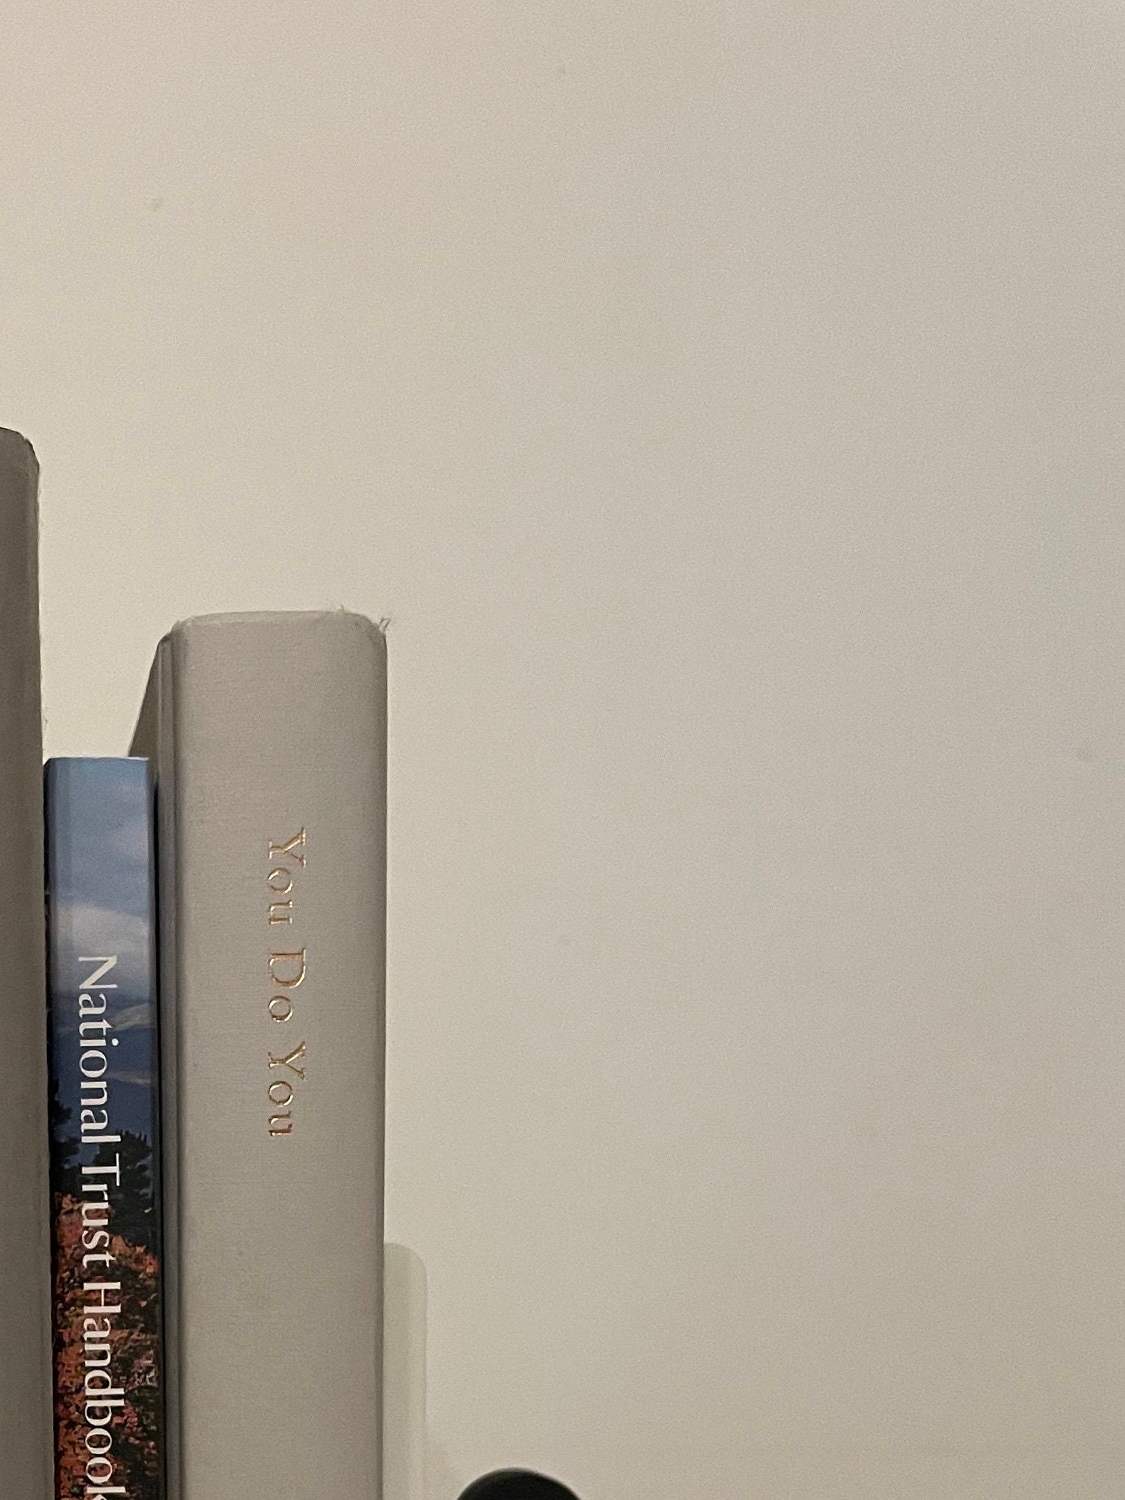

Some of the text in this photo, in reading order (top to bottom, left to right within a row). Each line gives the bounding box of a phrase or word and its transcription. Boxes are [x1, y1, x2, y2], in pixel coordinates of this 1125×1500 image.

[78, 954, 122, 1145] National
[267, 827, 307, 1138] You Do You
[81, 1152, 122, 1267] Trust
